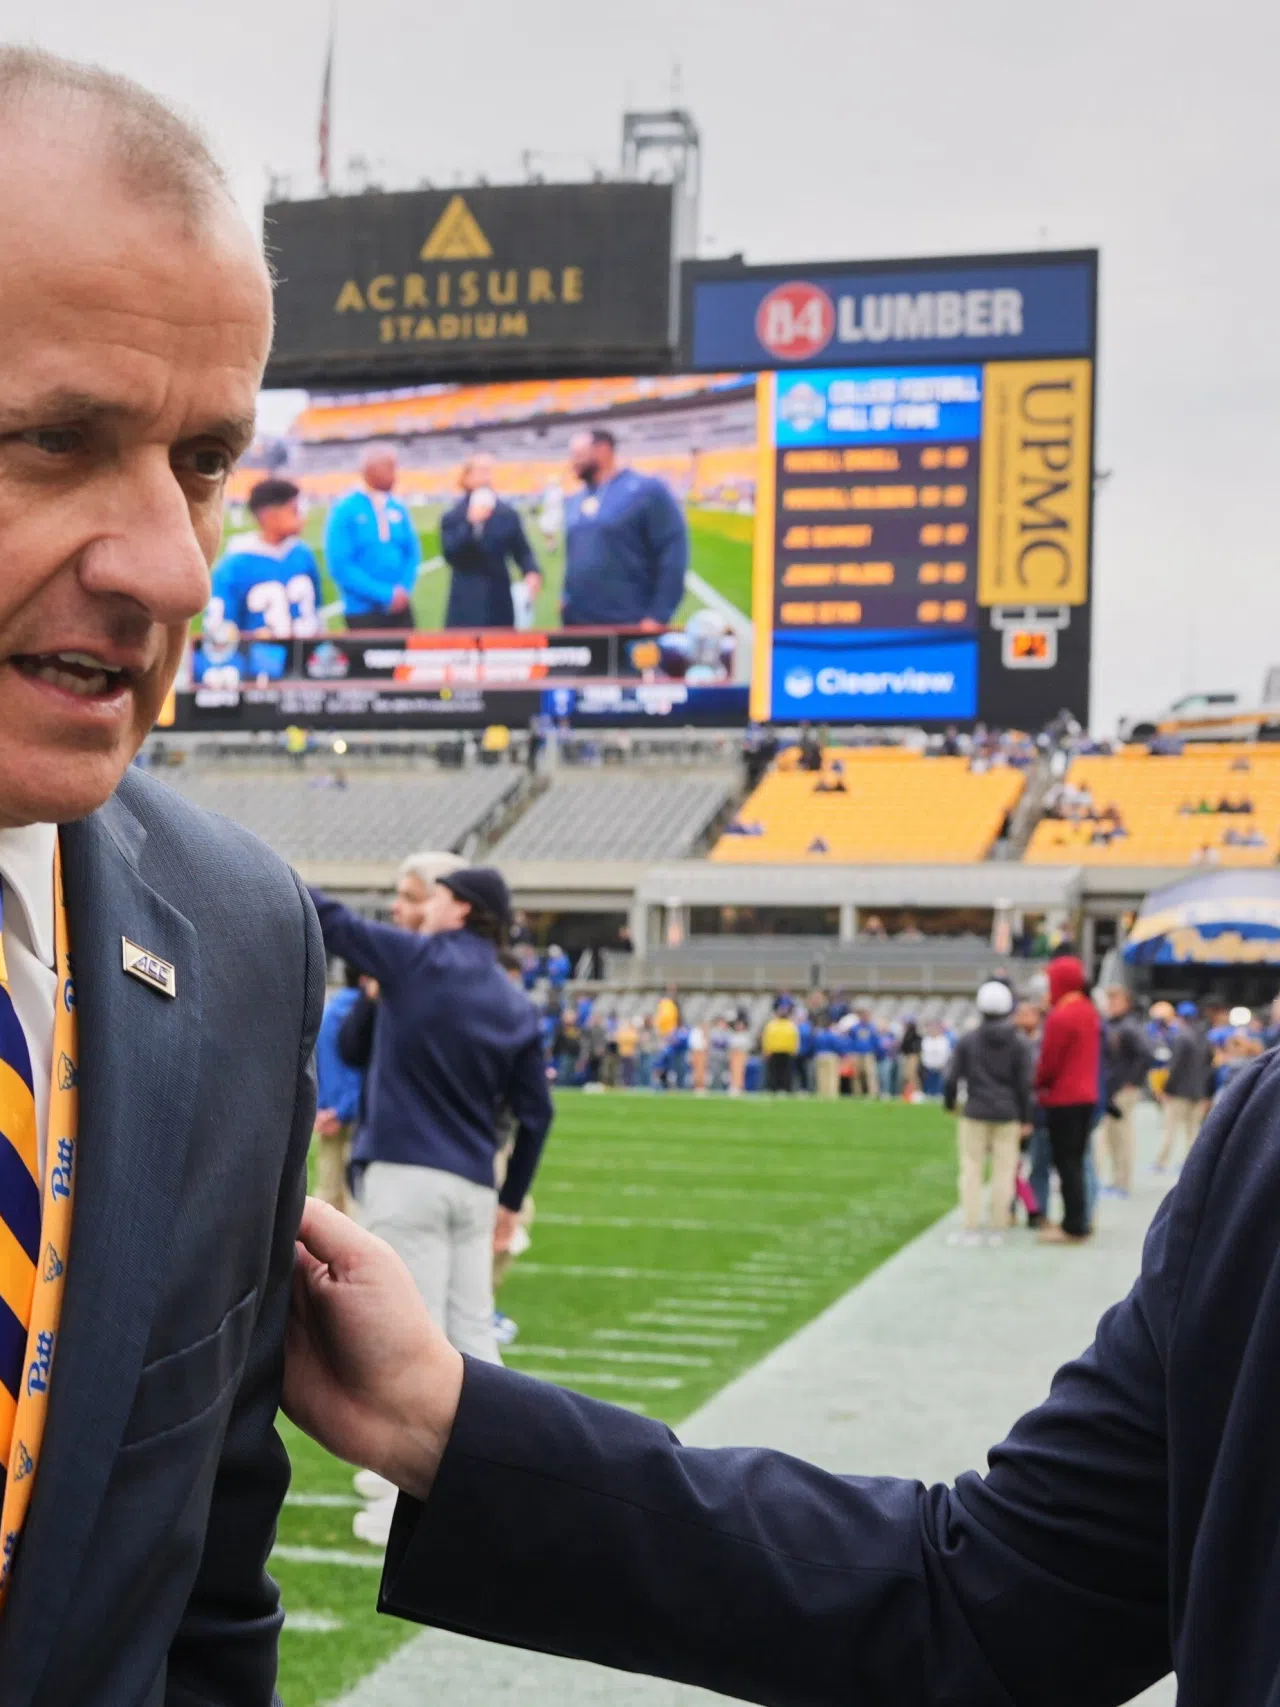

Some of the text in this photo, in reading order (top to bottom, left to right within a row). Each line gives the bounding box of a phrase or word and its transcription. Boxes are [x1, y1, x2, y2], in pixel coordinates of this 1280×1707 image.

[335, 266, 584, 315] ACRISURE
[765, 287, 1024, 344] 84 LUMBER
[379, 310, 529, 344] STADIUM
[1017, 379, 1072, 589] UPMC
[816, 667, 955, 695] Clearview
[131, 956, 168, 986] ACC
[51, 1137, 75, 1202] Pitt
[28, 1330, 55, 1397] Pitt
